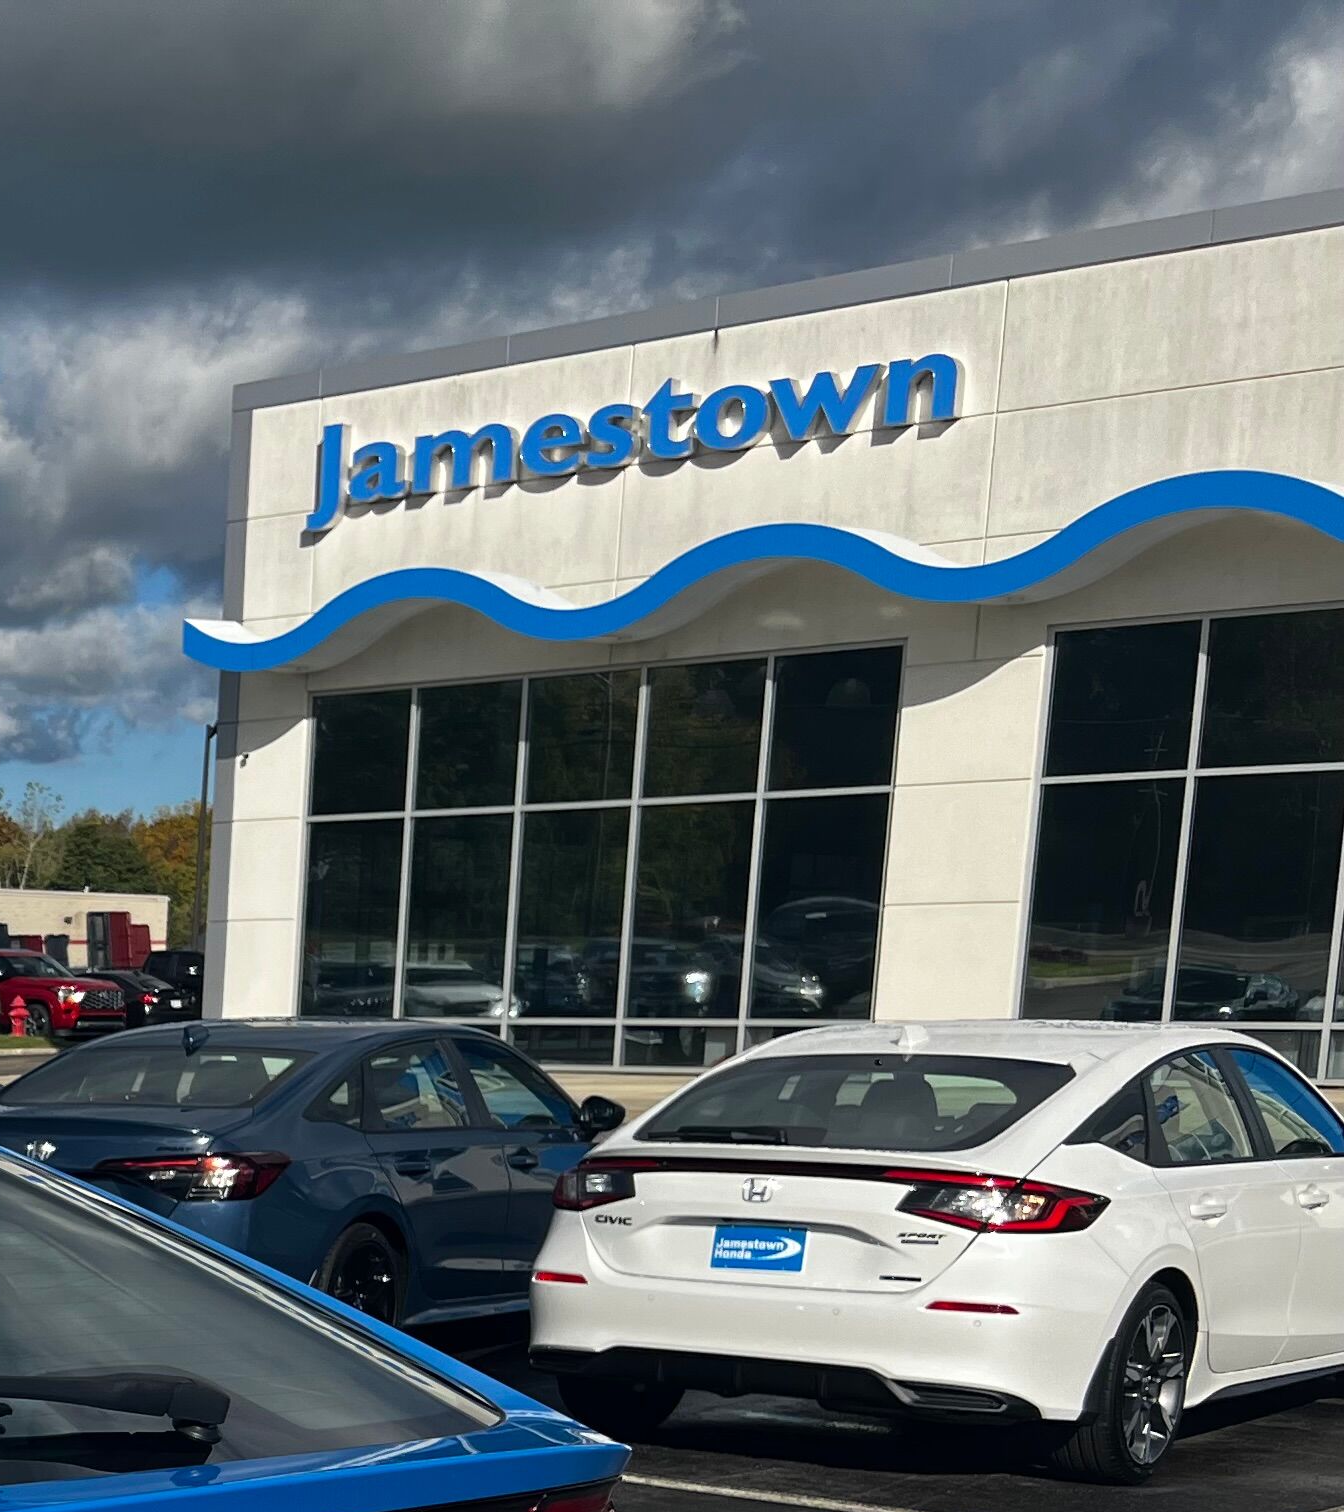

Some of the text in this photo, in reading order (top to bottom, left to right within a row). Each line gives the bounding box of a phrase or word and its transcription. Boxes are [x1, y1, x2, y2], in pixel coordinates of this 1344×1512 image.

[305, 351, 962, 533] Jamestown
[594, 1214, 633, 1226] CIVIC
[716, 1237, 785, 1251] Jamestown
[714, 1247, 752, 1260] Honda
